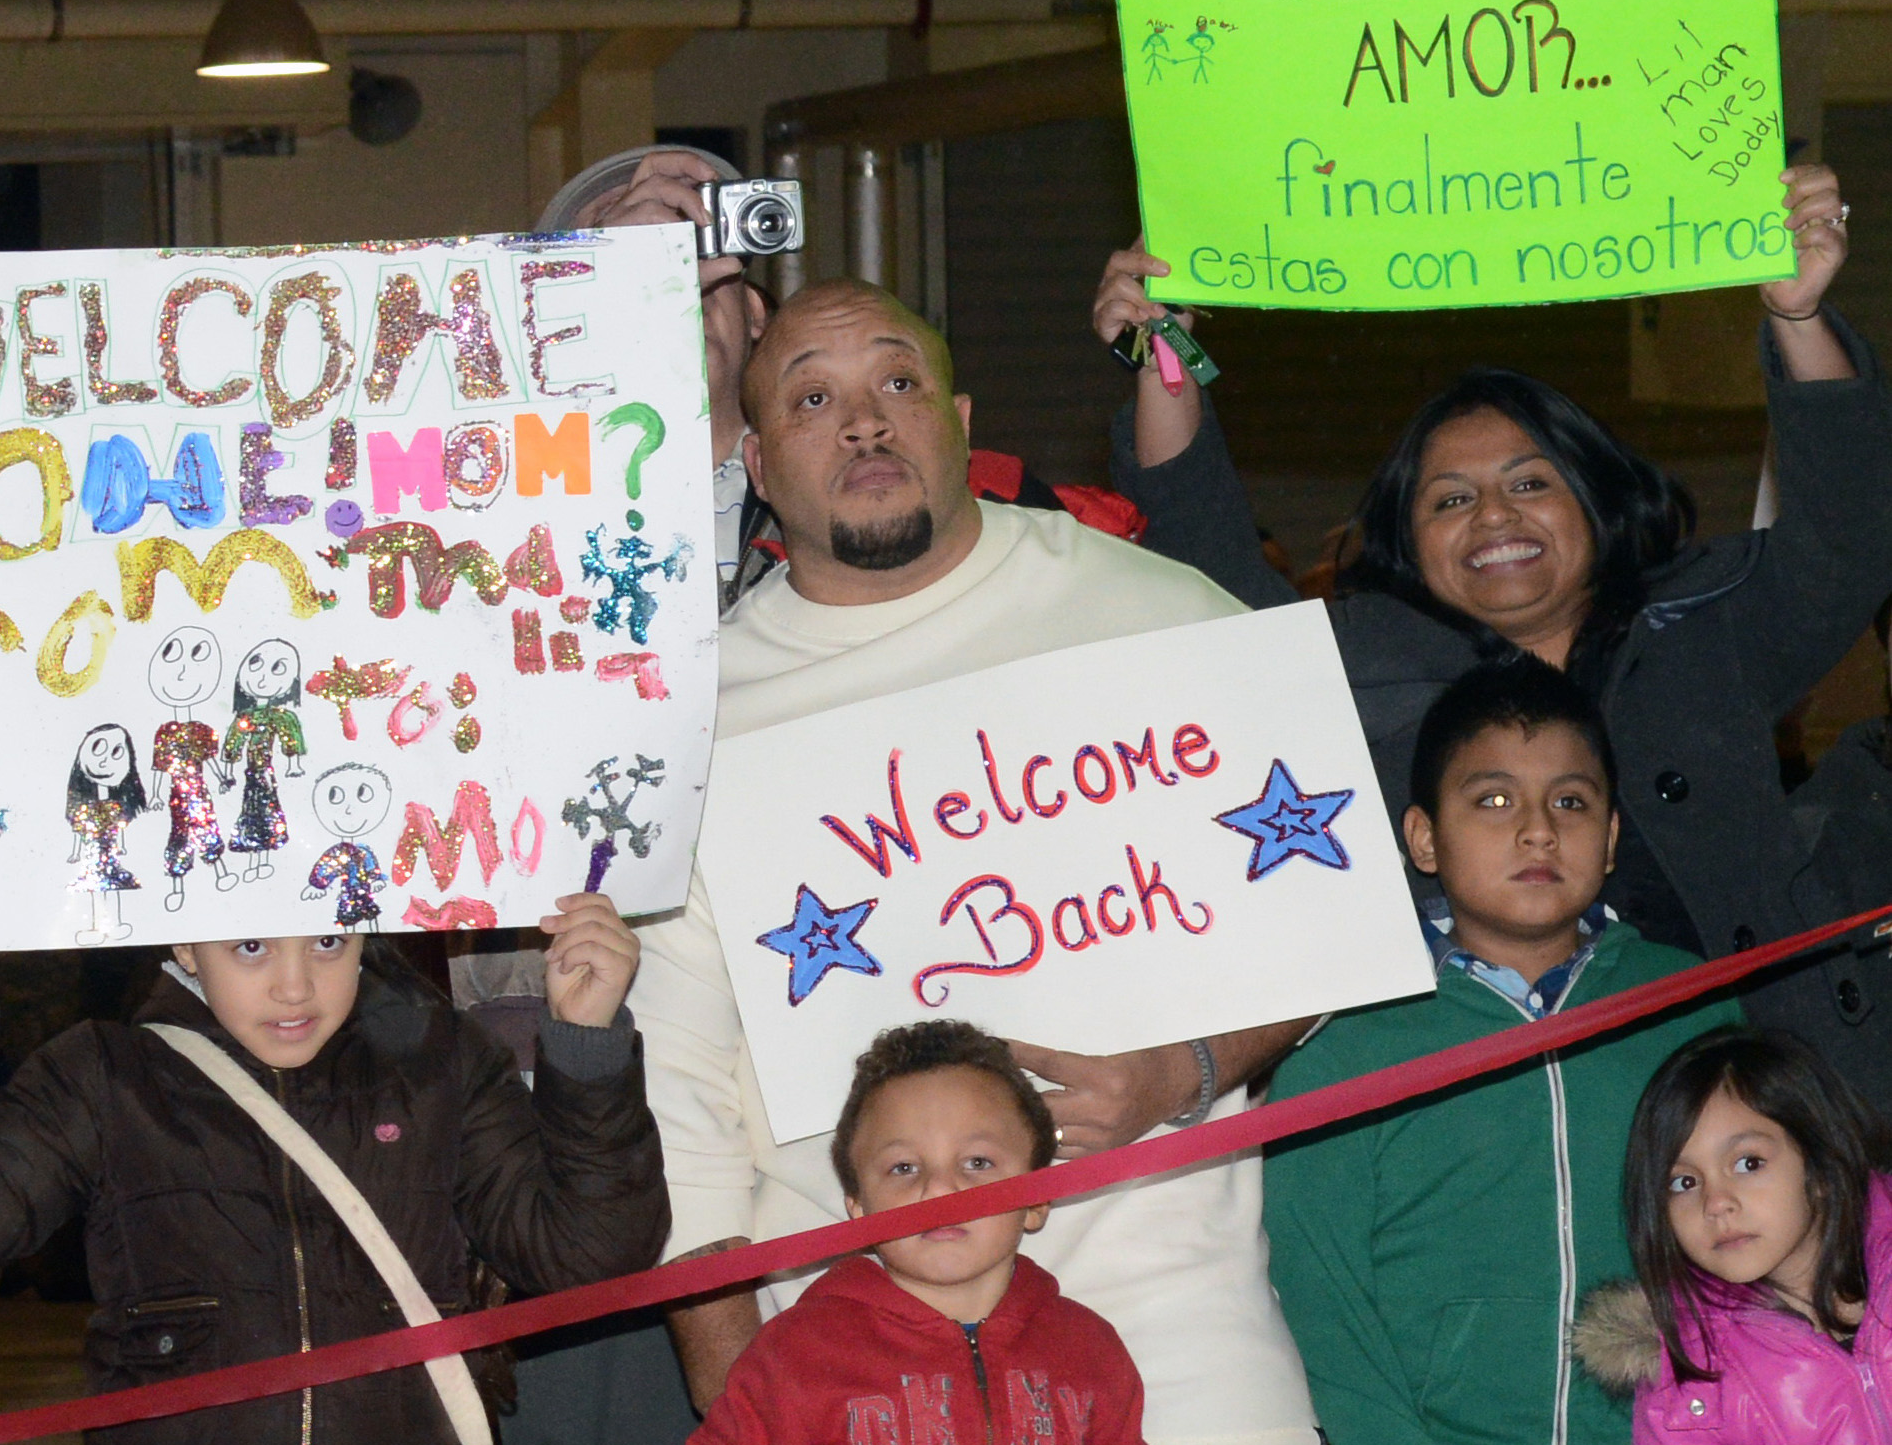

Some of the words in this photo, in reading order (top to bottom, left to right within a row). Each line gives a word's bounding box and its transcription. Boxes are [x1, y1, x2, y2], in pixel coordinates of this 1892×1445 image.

[1276, 120, 1633, 218] finalmente
[1189, 222, 1348, 297] estas
[1386, 248, 1478, 291] con
[1516, 195, 1788, 286] nosotros
[911, 843, 1214, 1008] Back
